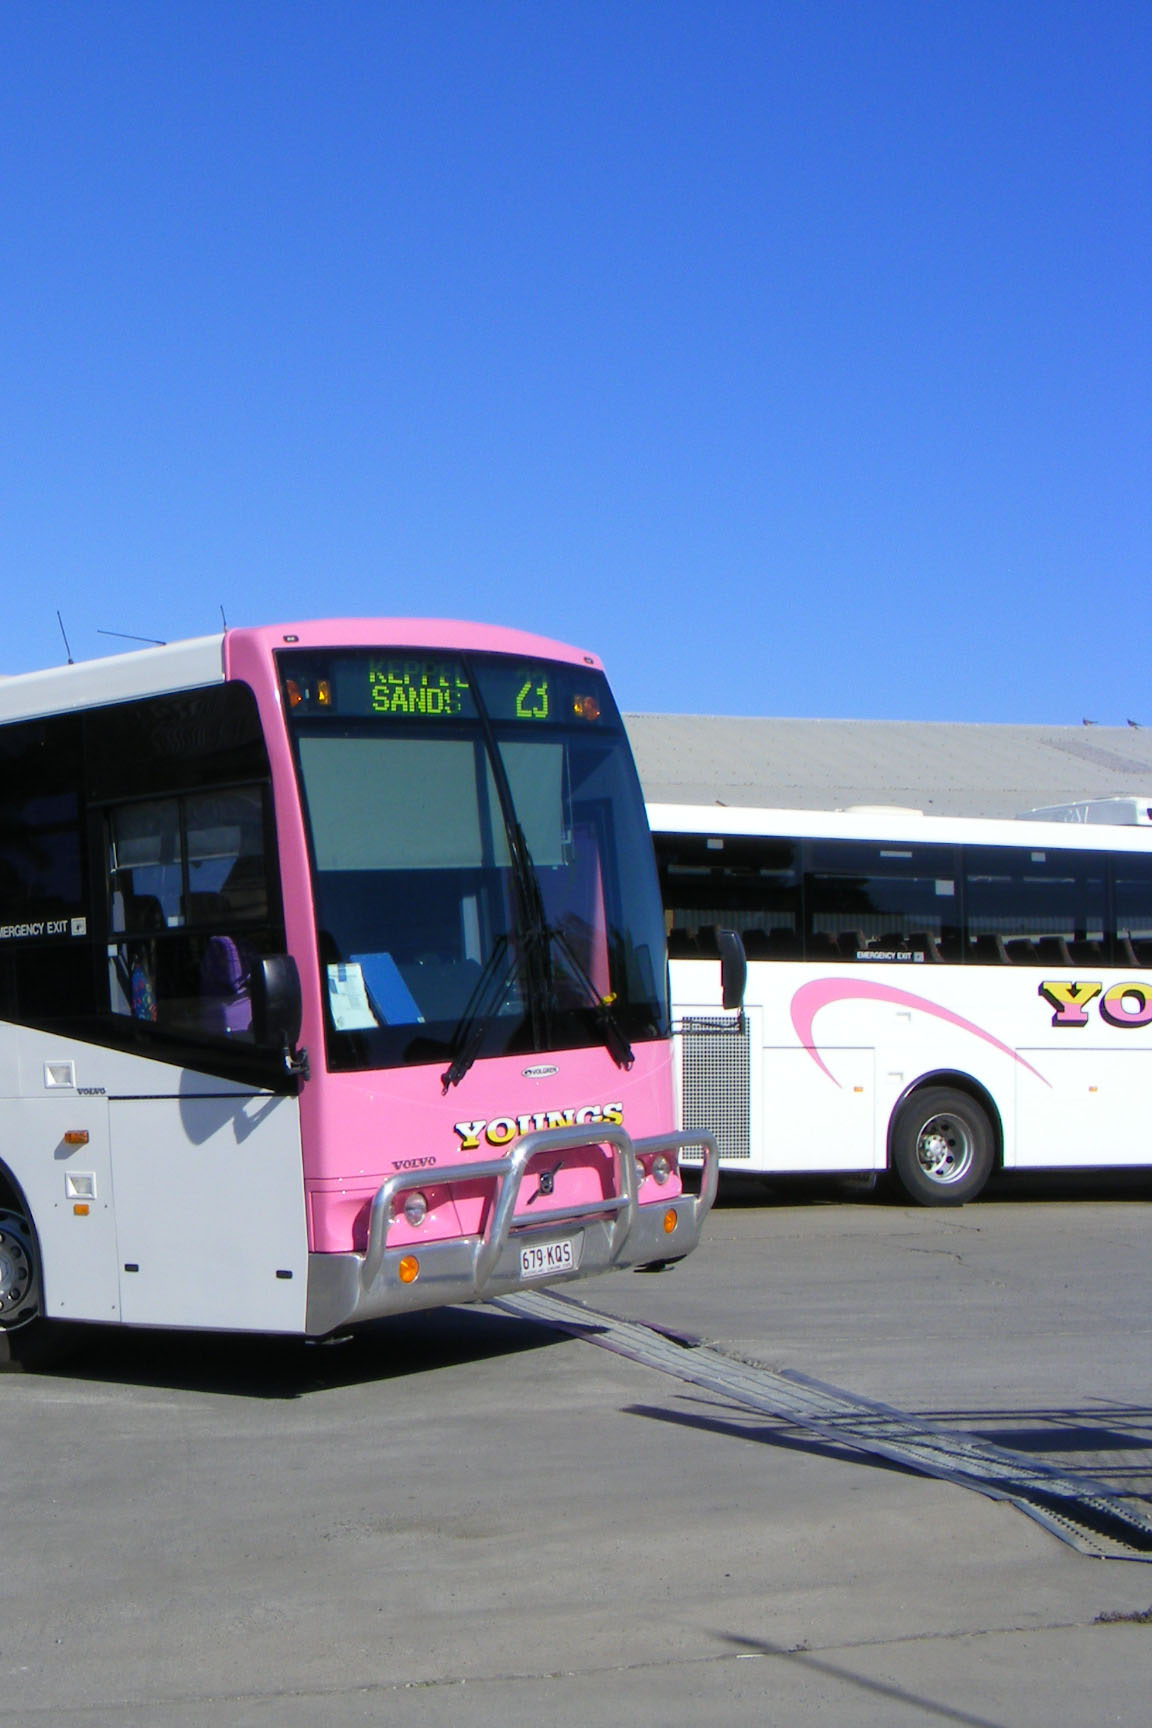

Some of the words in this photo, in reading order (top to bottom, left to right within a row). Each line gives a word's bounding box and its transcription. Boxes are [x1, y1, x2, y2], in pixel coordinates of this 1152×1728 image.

[372, 685, 461, 713] SANDS
[47, 920, 68, 934] EXIT
[856, 951, 896, 960] EMERGENCY
[896, 951, 912, 960] EXIT
[1038, 981, 1152, 1029] YO
[77, 1087, 106, 1096] VOLVO
[391, 1156, 437, 1171] VOLVO
[522, 1248, 544, 1271] 679
[546, 1243, 571, 1265] KQS
